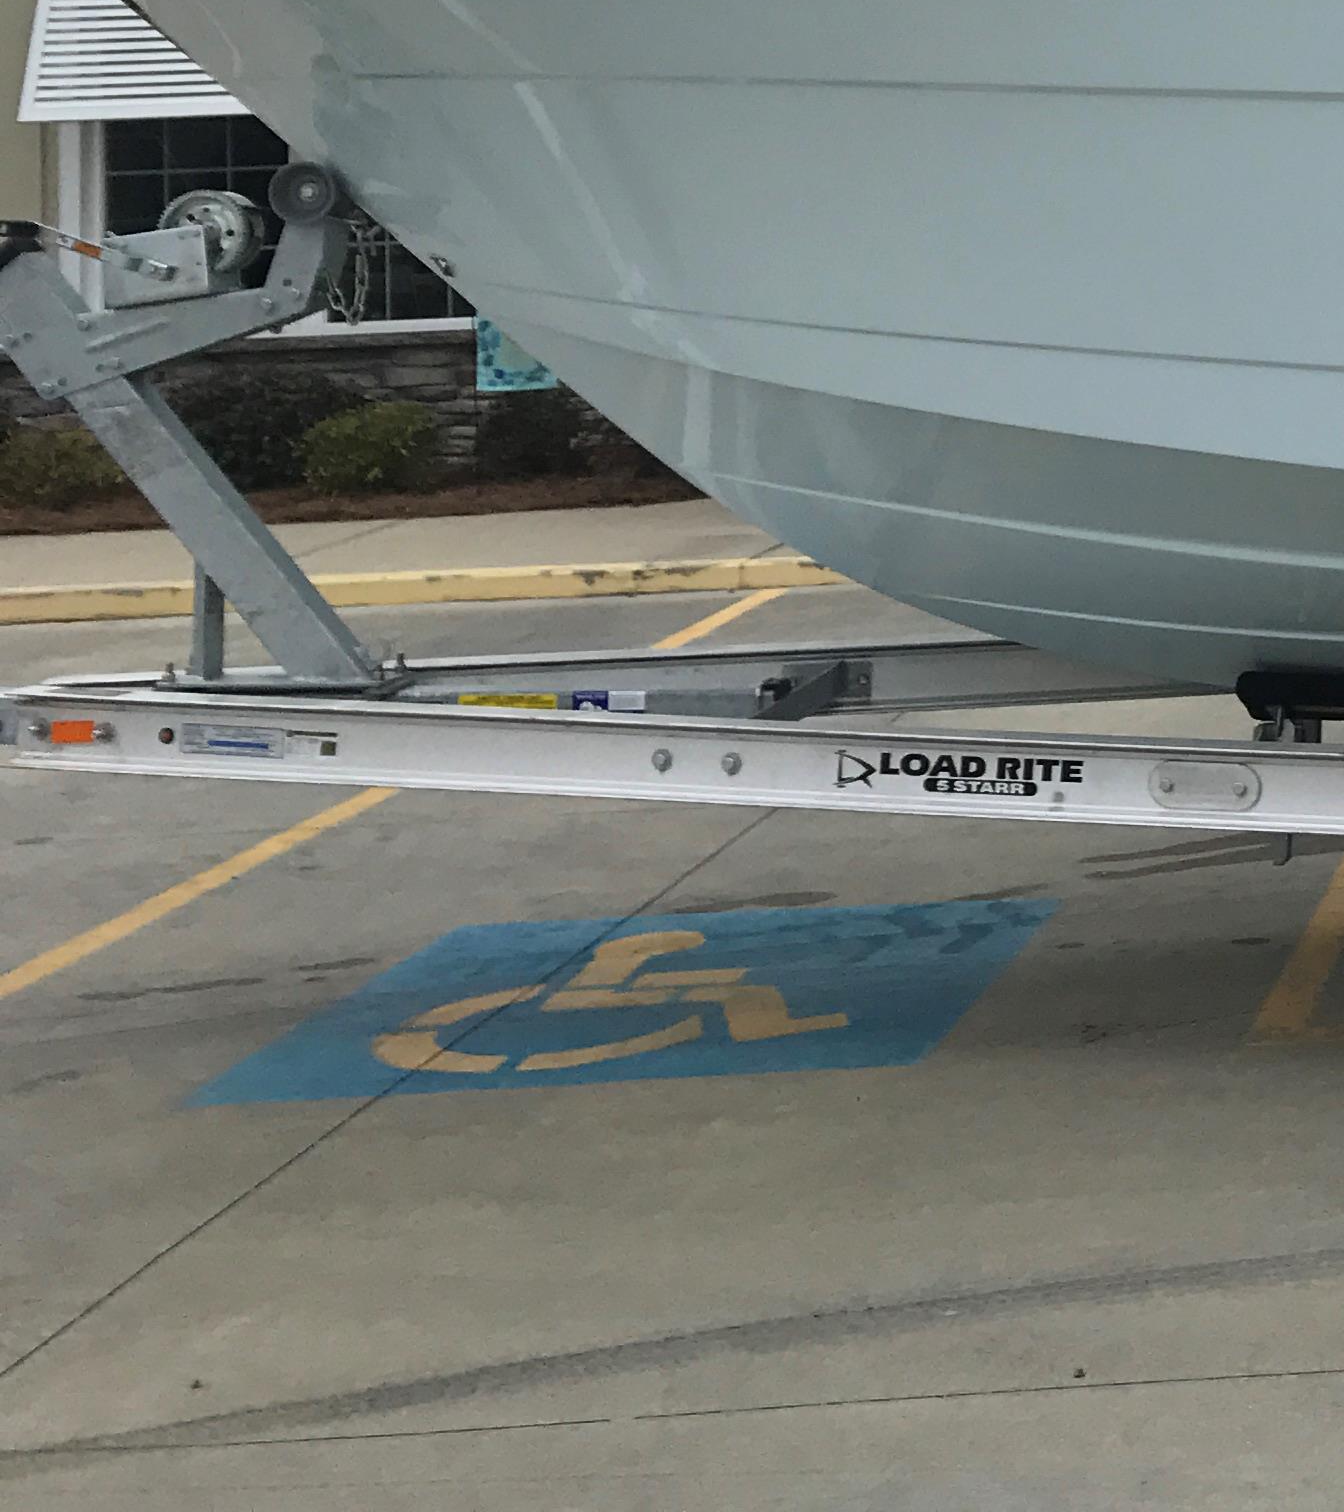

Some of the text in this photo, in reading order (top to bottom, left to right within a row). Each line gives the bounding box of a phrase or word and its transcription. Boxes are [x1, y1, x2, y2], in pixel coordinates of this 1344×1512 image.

[879, 751, 1085, 784] LOAD RITE
[952, 780, 1026, 795] STARR
